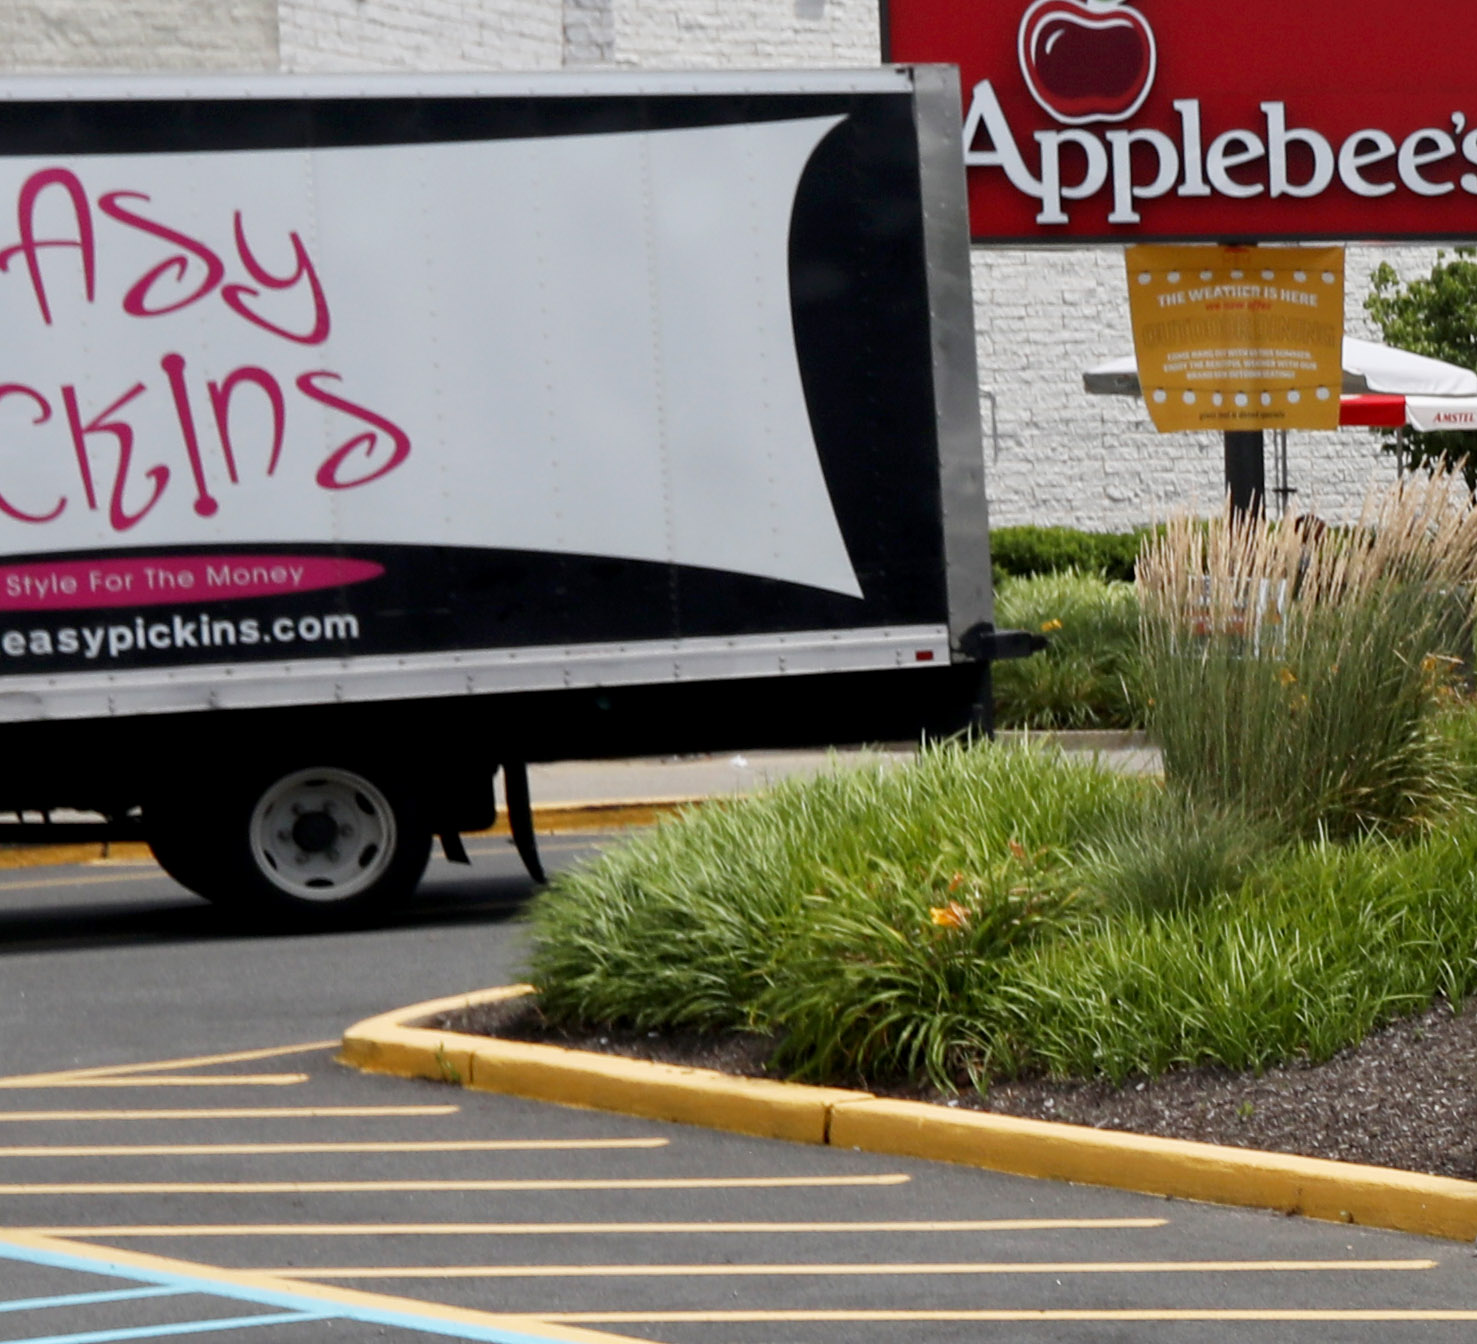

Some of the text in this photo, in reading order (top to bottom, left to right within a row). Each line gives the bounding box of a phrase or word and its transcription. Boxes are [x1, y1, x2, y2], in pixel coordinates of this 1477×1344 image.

[1157, 285, 1318, 307] THE WEATHER IS HERE
[1434, 412, 1474, 423] AMSTEL
[6, 563, 304, 599] Style For The Money
[1, 612, 360, 659] easypickins.com
